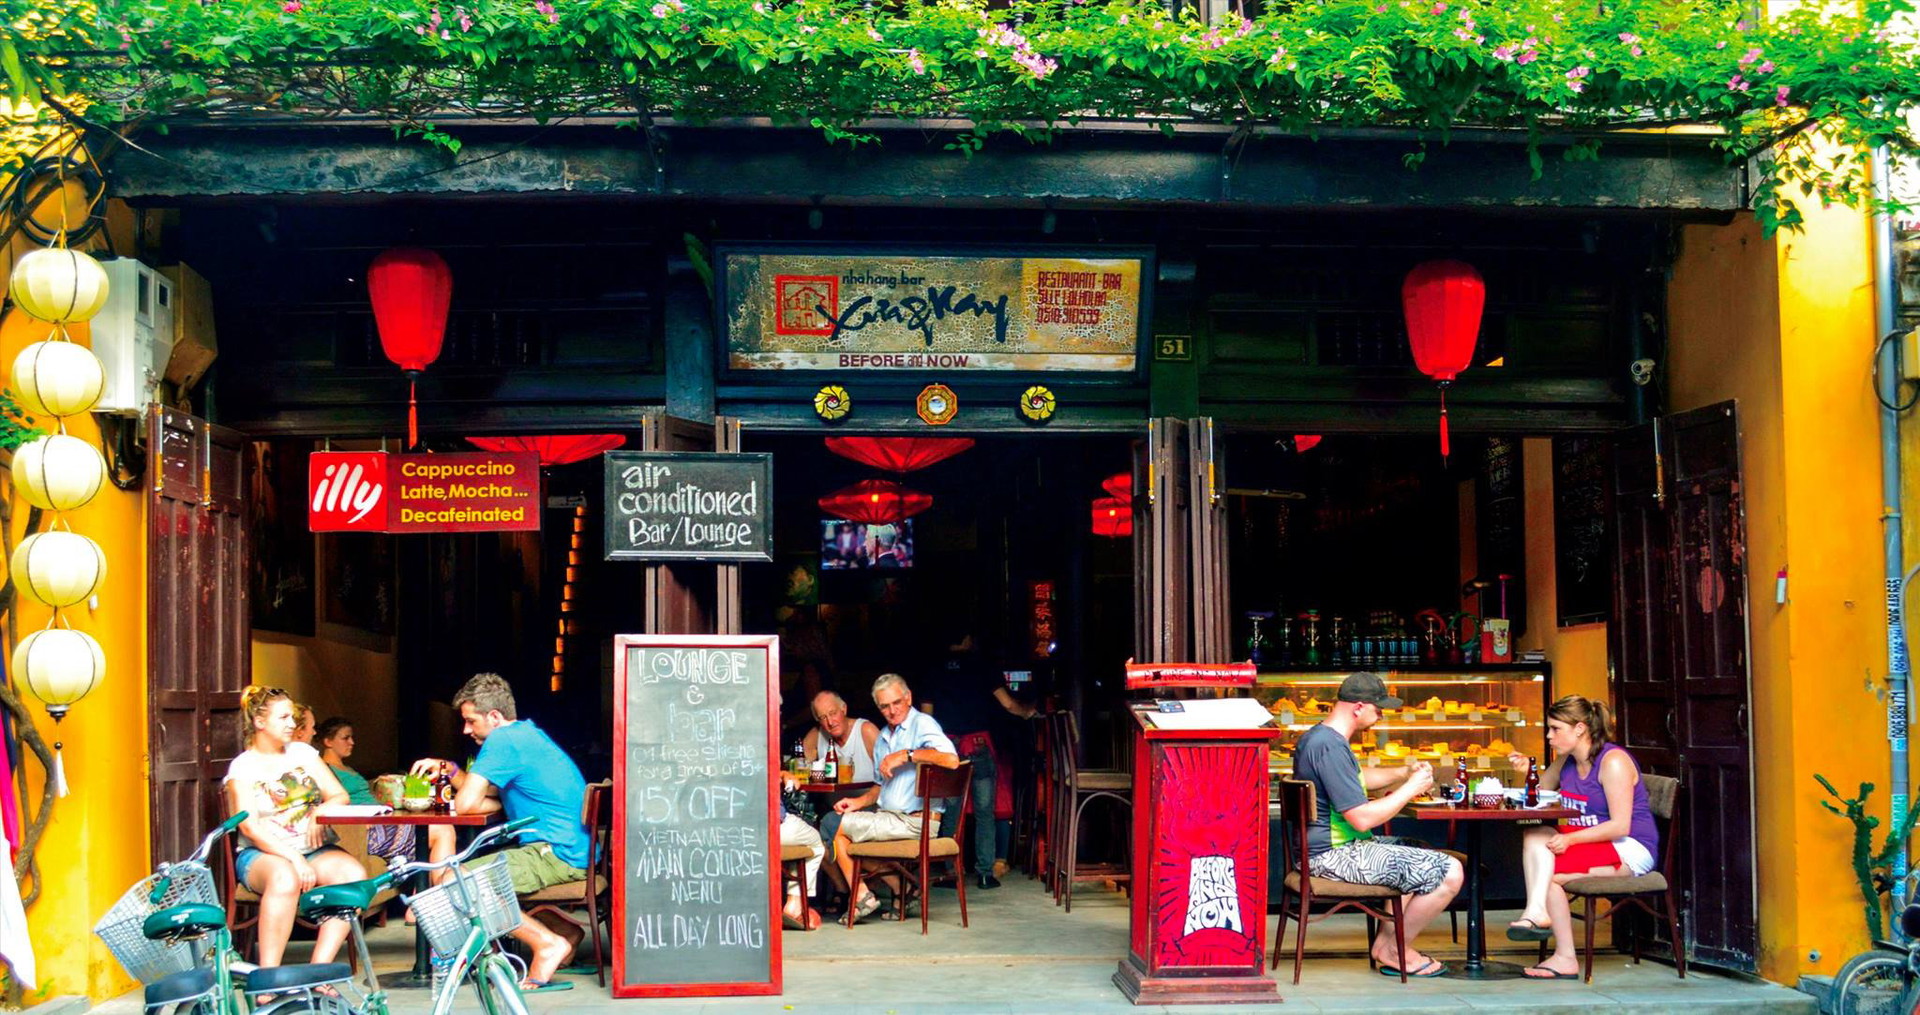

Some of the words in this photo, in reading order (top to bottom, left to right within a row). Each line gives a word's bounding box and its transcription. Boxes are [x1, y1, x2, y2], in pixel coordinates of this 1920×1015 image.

[1038, 271, 1097, 289] RESTAURANT
[1103, 273, 1122, 290] BAR
[1162, 339, 1185, 355] 51
[839, 354, 904, 368] BEFORE
[927, 354, 969, 369] NOW
[401, 460, 516, 480] Cappuccino
[621, 462, 671, 489] air
[312, 462, 383, 524] illy
[618, 478, 757, 517] conditioned
[400, 507, 524, 523] Decafeinated
[637, 649, 750, 685] LOUNGE
[686, 685, 704, 704] &
[660, 745, 700, 763] free
[688, 785, 748, 820] OFF
[638, 826, 757, 848] VIETNAMESE
[636, 846, 684, 883] MAIN
[689, 847, 764, 879] COURSE
[671, 880, 723, 905] MENU
[633, 914, 667, 949] ALL
[674, 914, 710, 949] DAY
[718, 913, 764, 949] LONG
